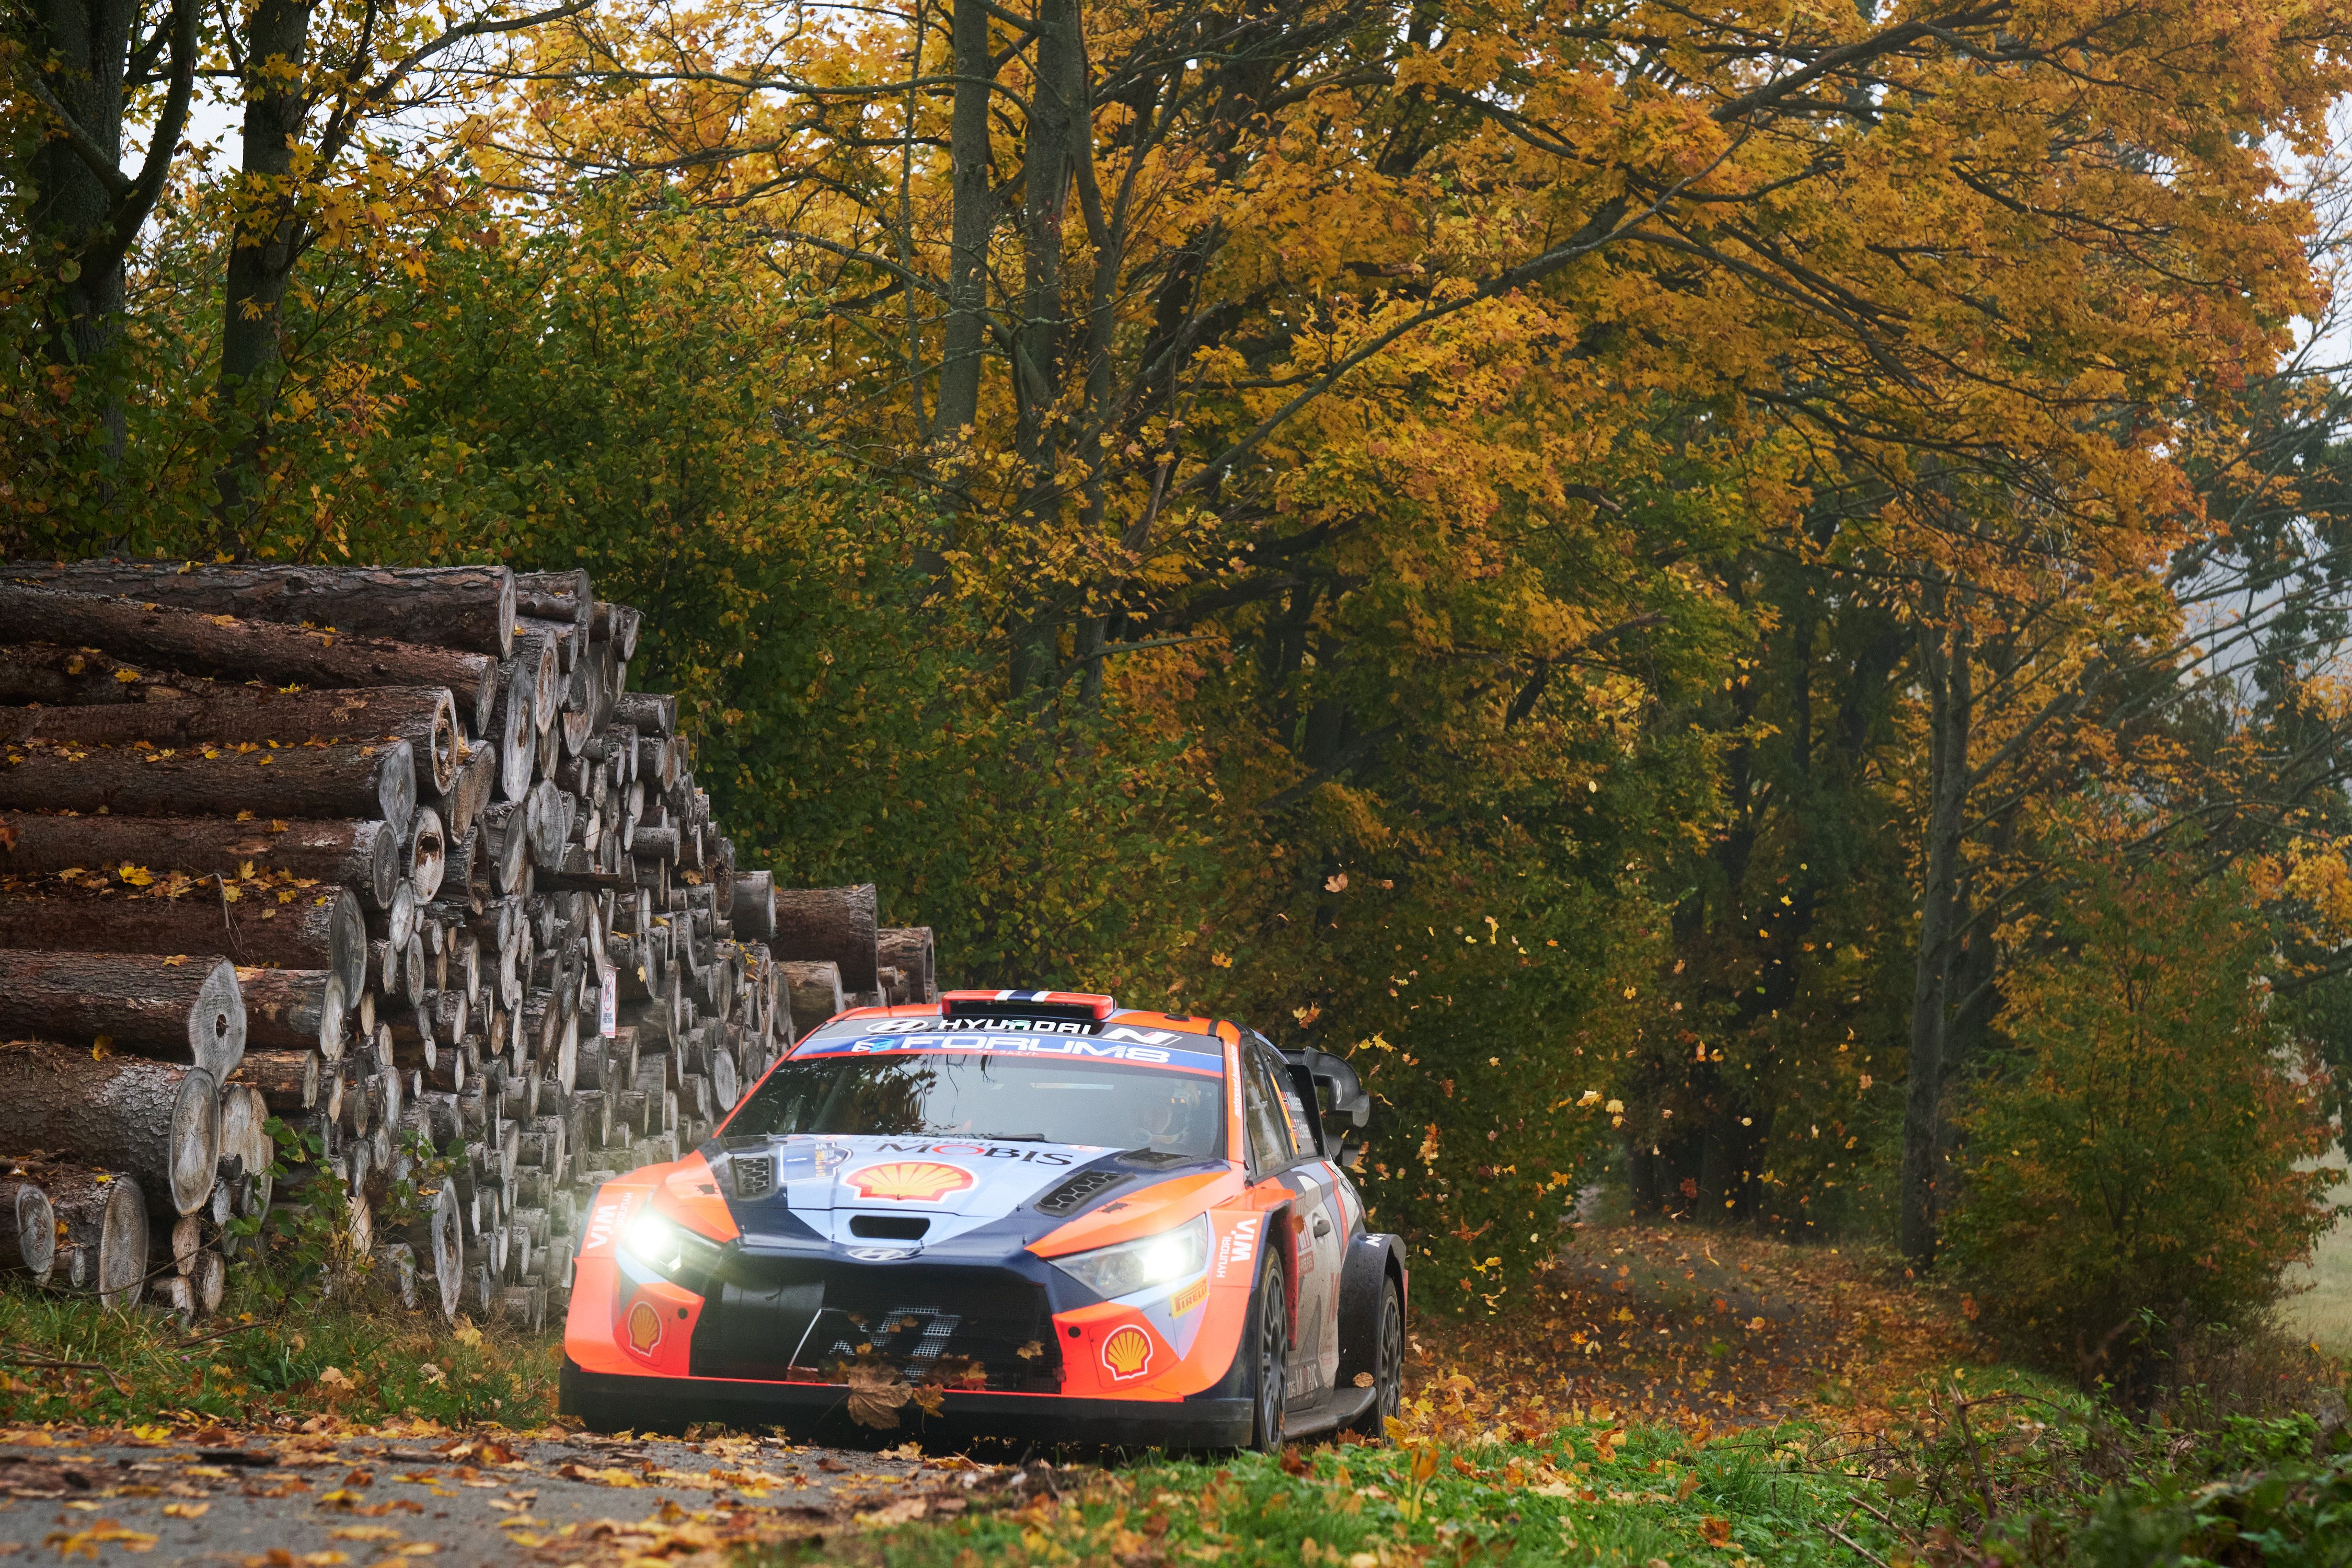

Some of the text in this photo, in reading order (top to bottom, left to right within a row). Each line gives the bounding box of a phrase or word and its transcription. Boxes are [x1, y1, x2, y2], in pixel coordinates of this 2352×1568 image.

[938, 1019, 1091, 1035] HYUNDAI
[901, 1036, 1171, 1064] FORUM8
[1229, 1044, 1242, 1119] motorsport.hyundai.com
[858, 1138, 995, 1147] HYUNDAI
[872, 1143, 1074, 1166] MOBIS
[1230, 1218, 1257, 1262] WIA
[1216, 1236, 1232, 1278] HYUNDAI
[1174, 1280, 1208, 1312] PIRELLI
